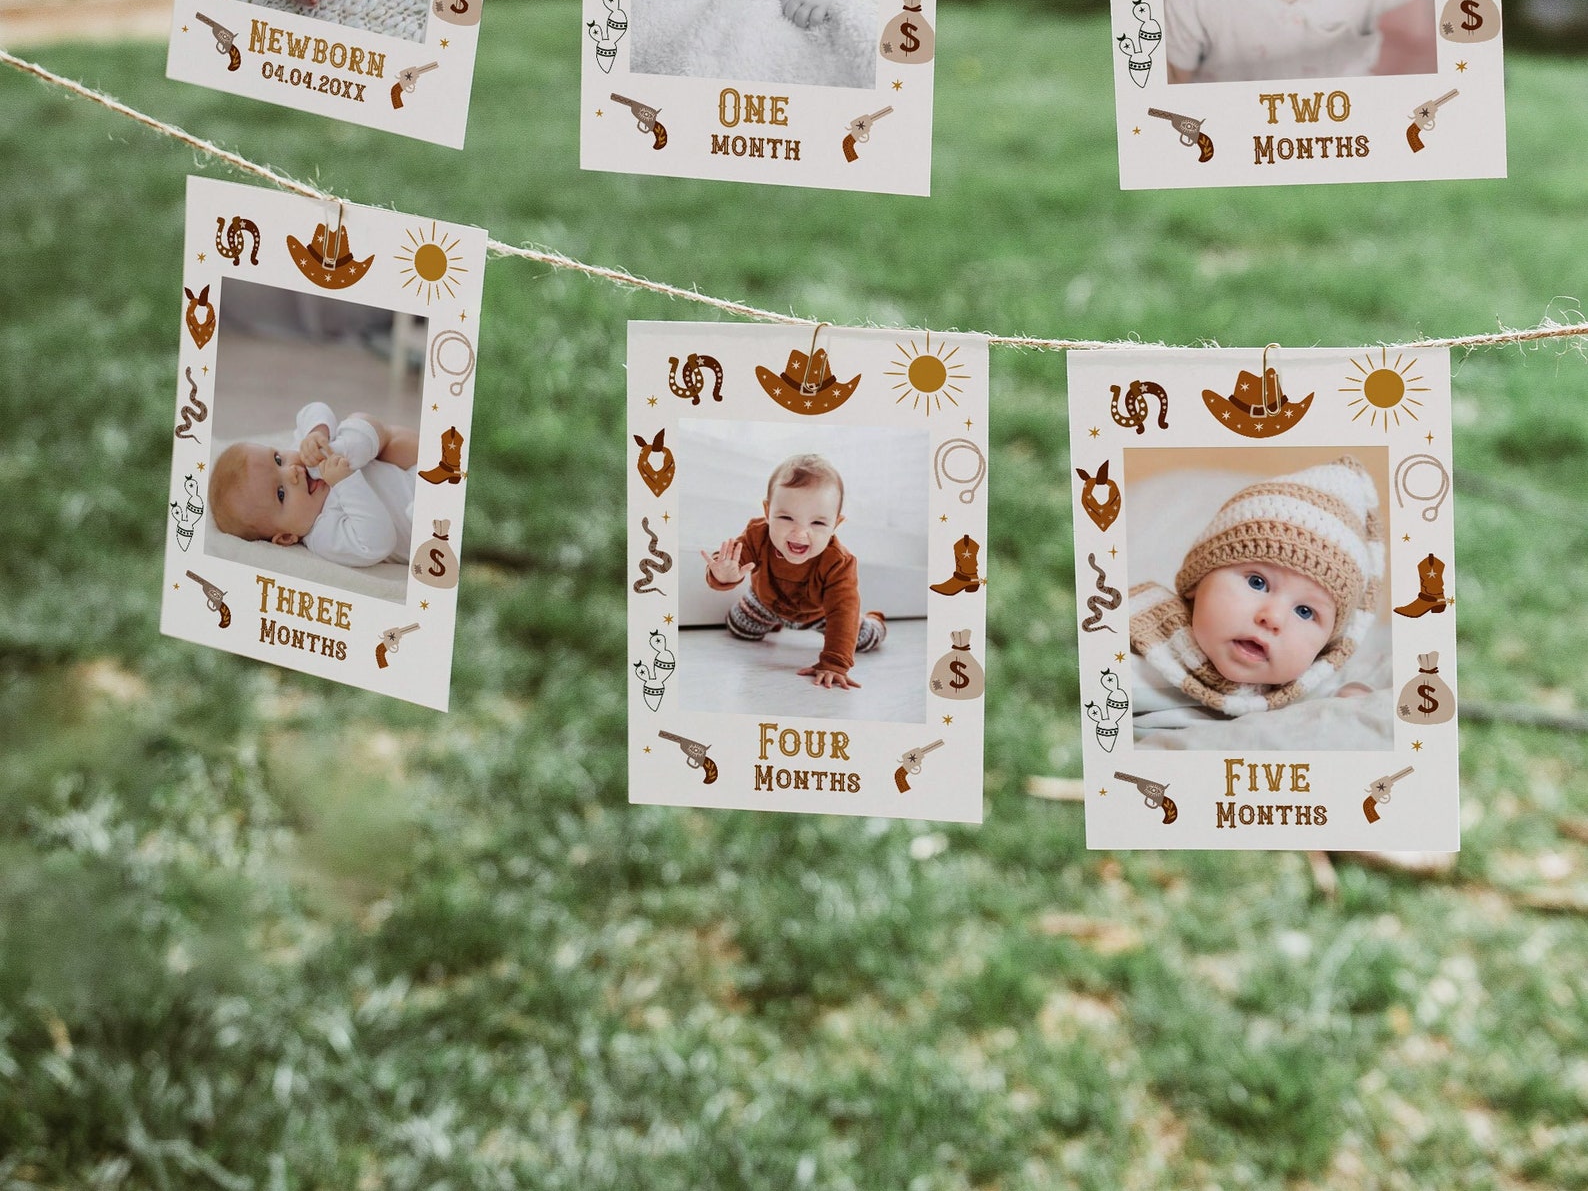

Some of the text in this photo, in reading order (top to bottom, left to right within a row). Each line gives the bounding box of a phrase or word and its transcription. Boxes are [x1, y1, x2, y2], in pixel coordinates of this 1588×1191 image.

[248, 19, 387, 79] NEWBORN
[261, 61, 367, 103] 04.04.20XX
[718, 87, 789, 128] ONE
[1258, 90, 1352, 125] TWO
[710, 133, 802, 161] MONTH
[1252, 134, 1370, 165] MONTHS
[255, 574, 353, 631] THREE
[258, 617, 348, 661] MONTHS
[758, 722, 851, 761] FOUR
[754, 764, 861, 793] MONTHS
[1223, 757, 1311, 797] FIVE
[1215, 801, 1328, 829] MONTHS
